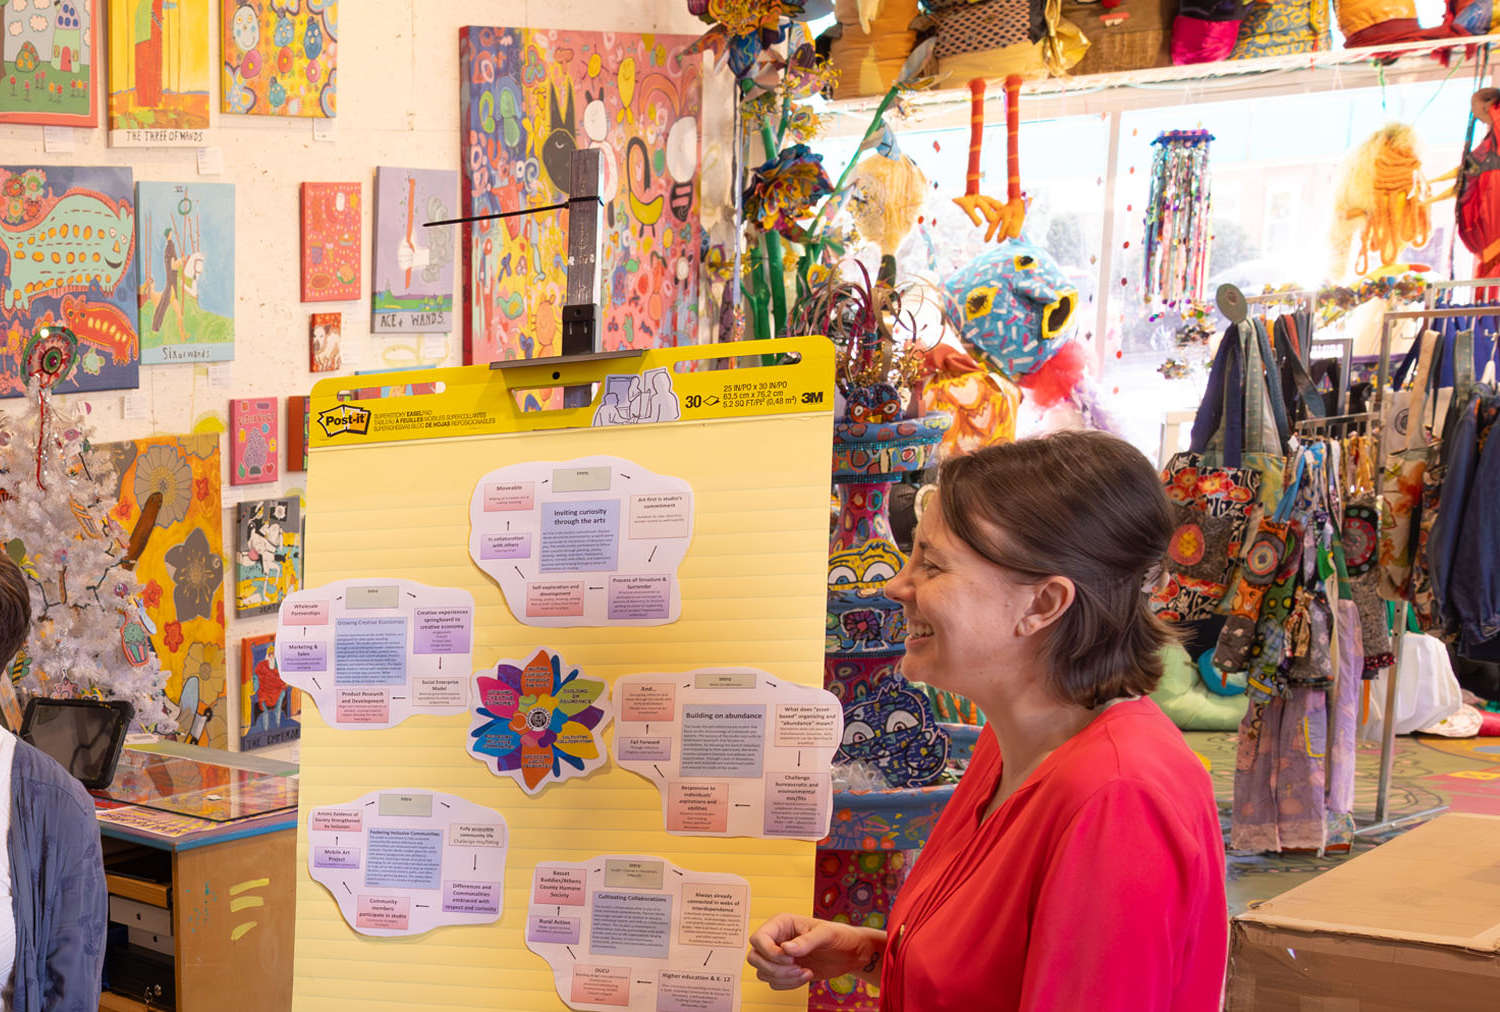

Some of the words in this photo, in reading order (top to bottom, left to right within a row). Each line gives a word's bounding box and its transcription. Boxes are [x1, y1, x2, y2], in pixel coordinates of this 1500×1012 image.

[127, 131, 140, 141] THE
[145, 131, 167, 141] THREE
[169, 131, 178, 141] OF
[180, 132, 203, 142] WANDS
[381, 314, 396, 327] ACE
[163, 347, 177, 359] Six
[734, 383, 751, 391] IN/PO
[769, 381, 787, 389] IN/PO
[685, 395, 701, 408] 30
[801, 392, 824, 404] 3M
[326, 414, 365, 426] Post-it
[554, 509, 577, 517] Inviting
[579, 508, 607, 516] curiosity
[554, 518, 584, 526] through
[246, 737, 260, 748] THE
